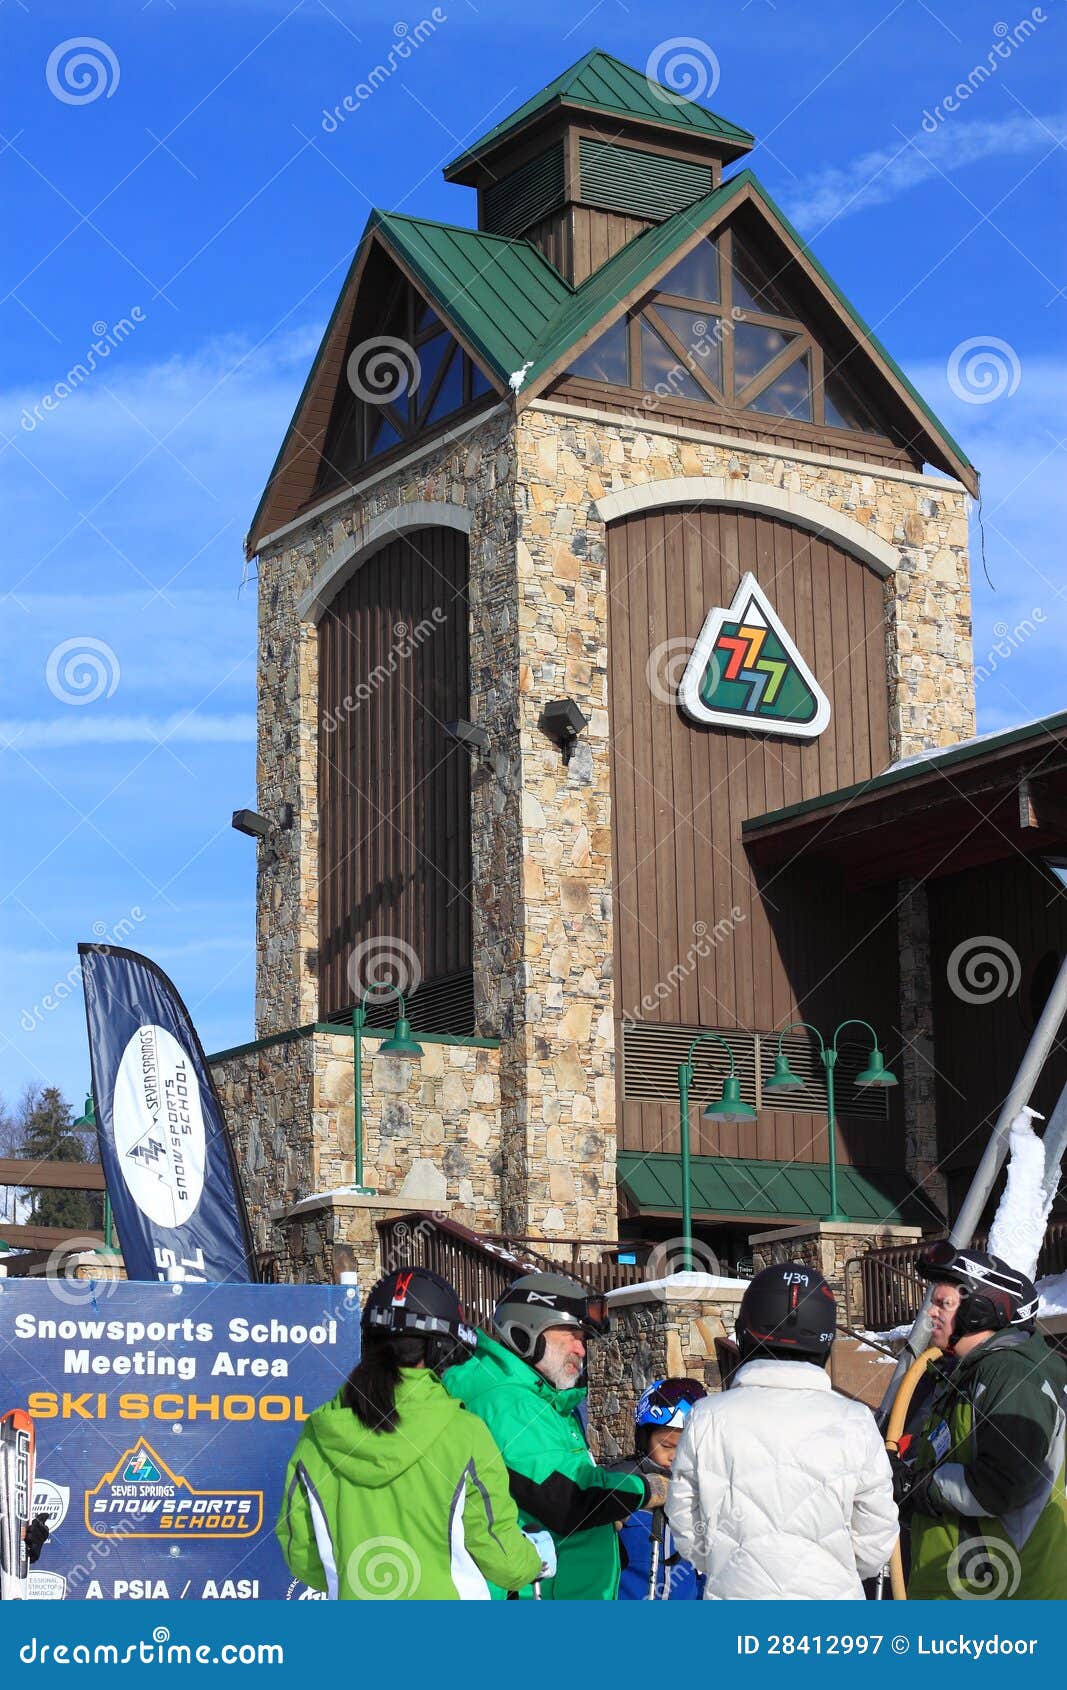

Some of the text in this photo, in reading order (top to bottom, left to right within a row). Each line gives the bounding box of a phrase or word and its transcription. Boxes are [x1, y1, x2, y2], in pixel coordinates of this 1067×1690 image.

[139, 1030, 156, 1073] SPRINGS
[175, 1060, 193, 1136] SCHOOL
[783, 1271, 809, 1287] 439
[14, 1313, 338, 1346] Snowsports School
[64, 1349, 289, 1380] Meeting Area
[27, 1391, 311, 1422] SKI SCHOOL
[111, 1485, 176, 1498] SEVEN SPRINGS
[93, 1499, 252, 1514] SNOWSPORTS
[159, 1514, 250, 1529] SCHOOL
[85, 1579, 259, 1600] A PSIA / AASI
